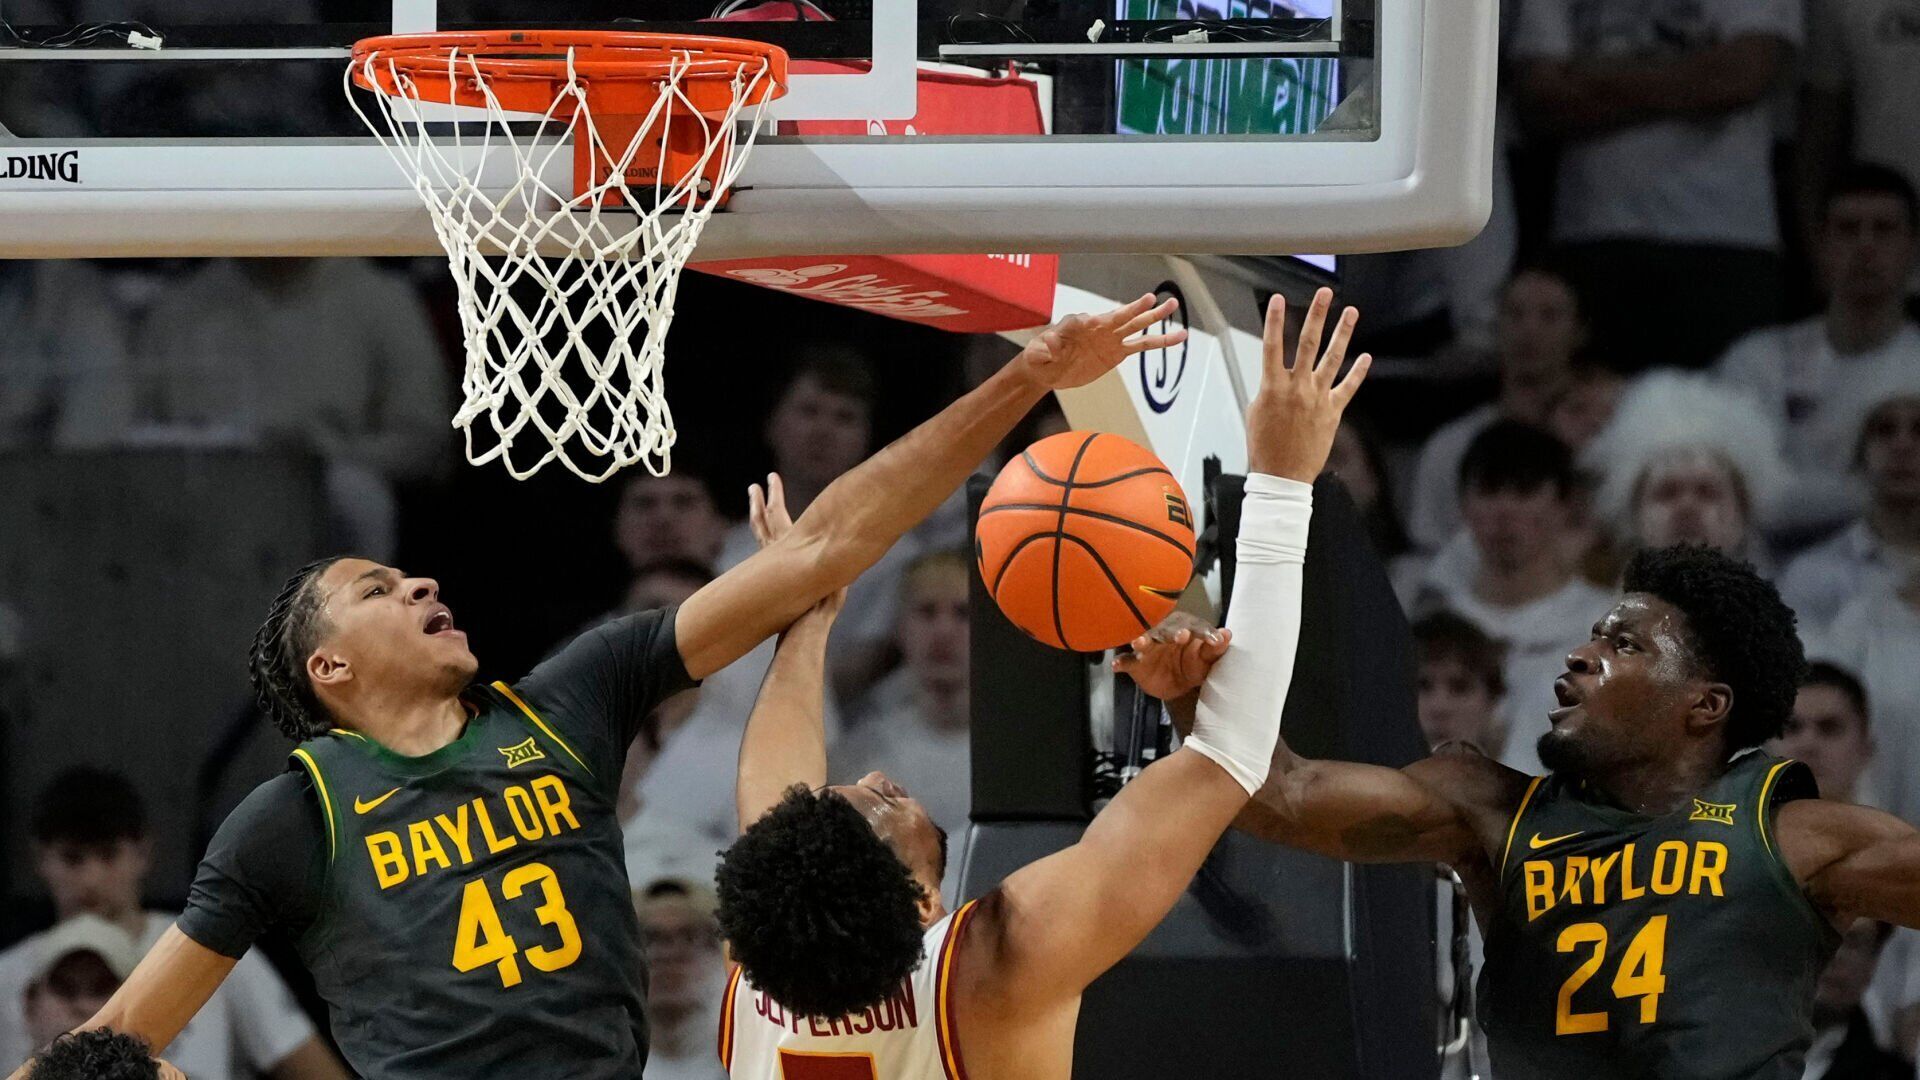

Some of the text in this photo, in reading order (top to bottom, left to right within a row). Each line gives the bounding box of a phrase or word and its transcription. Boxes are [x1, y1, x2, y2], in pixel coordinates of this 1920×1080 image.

[602, 166, 659, 178] SLDING
[365, 774, 582, 890] BAYLOR
[1523, 840, 1729, 922] BAYLOR
[452, 862, 583, 988] 43
[1555, 914, 1668, 1036] 24
